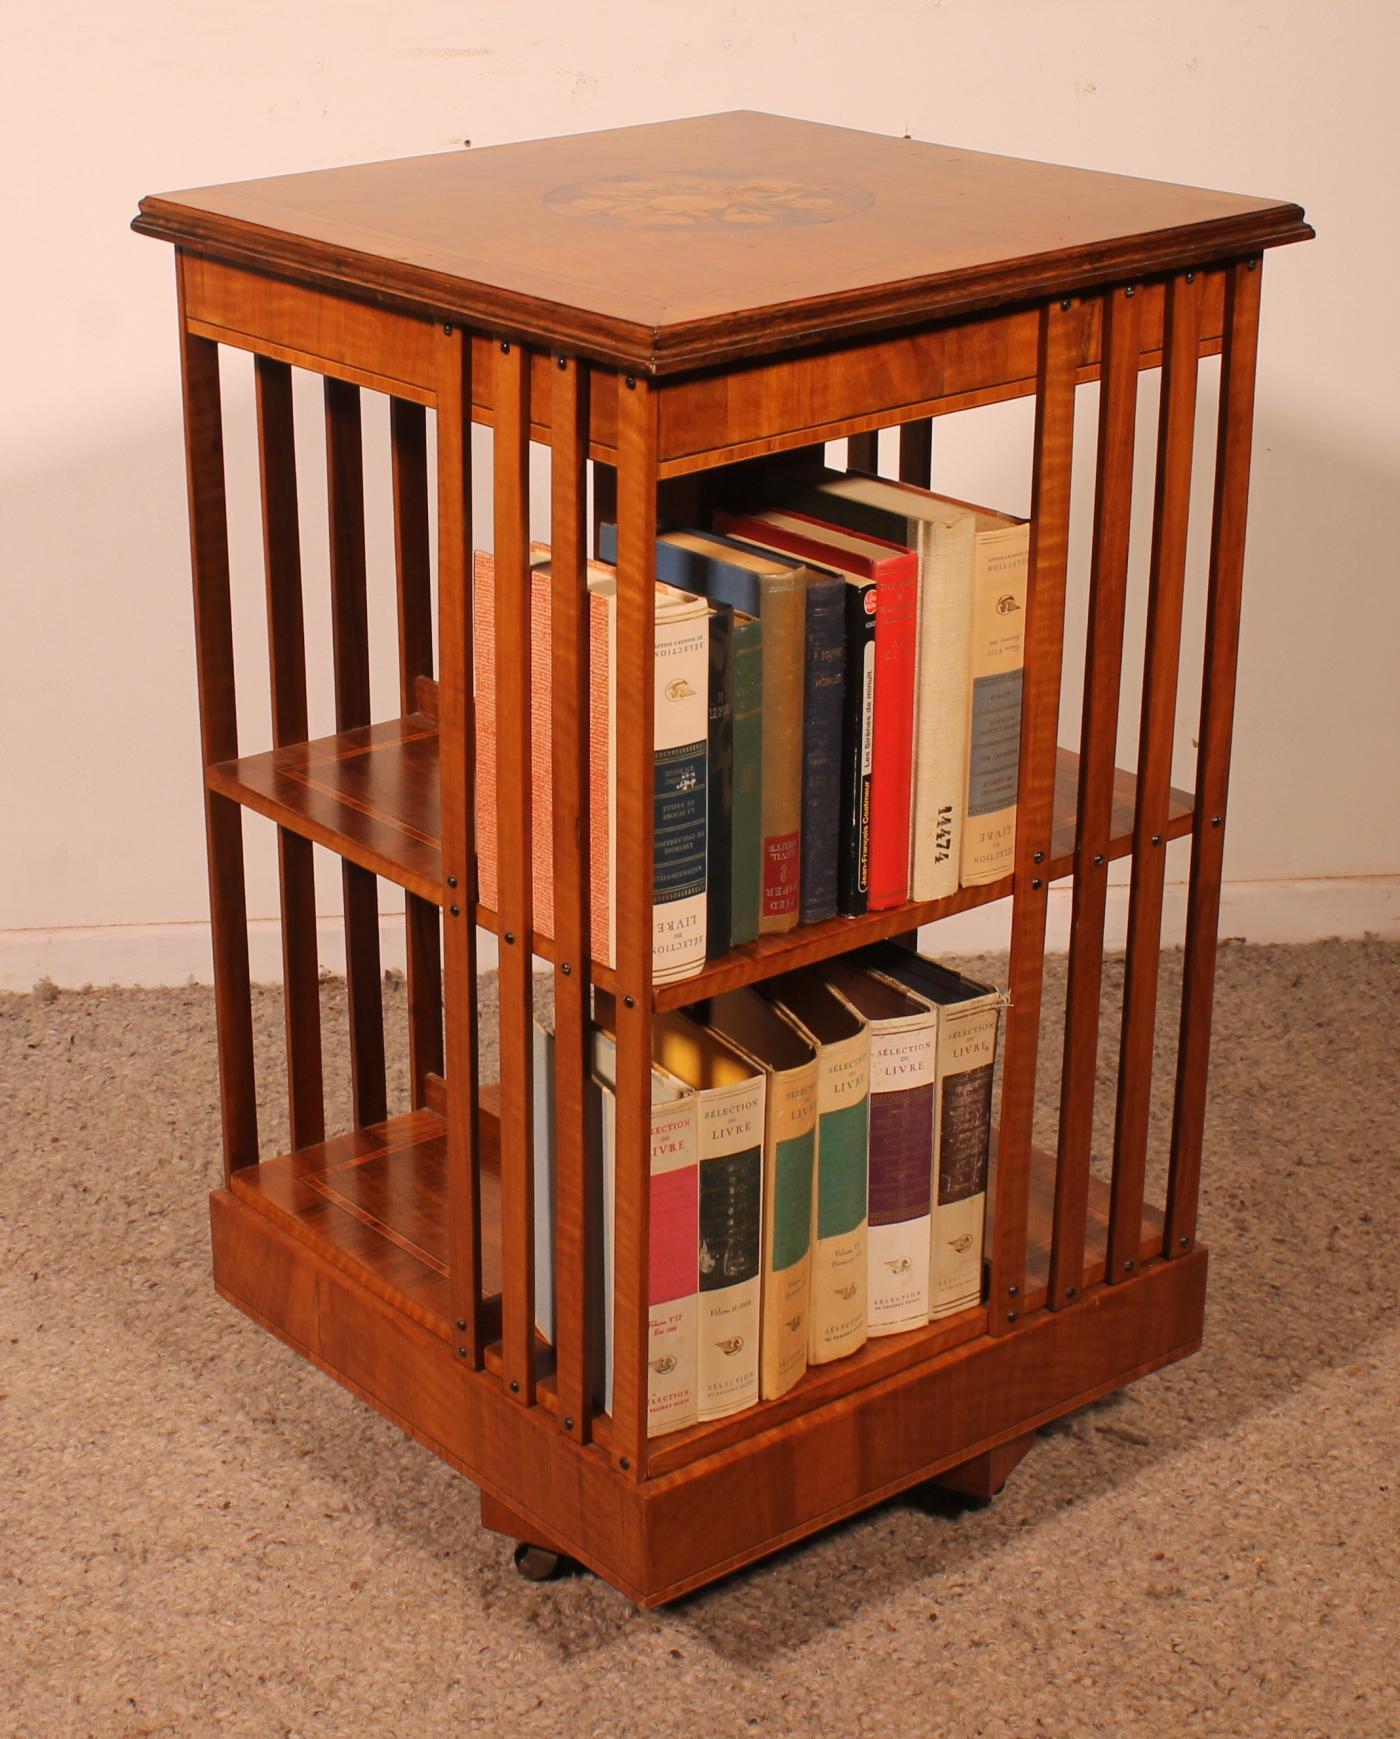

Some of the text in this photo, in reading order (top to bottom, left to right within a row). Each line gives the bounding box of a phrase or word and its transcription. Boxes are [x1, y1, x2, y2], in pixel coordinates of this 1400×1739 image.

[865, 701, 872, 714] de
[861, 825, 870, 887] Jean-François
[657, 914, 697, 933] LIVRE
[947, 1022, 994, 1040] SÉLECTION
[877, 1041, 931, 1057] SÉLECTION
[953, 1041, 988, 1058] LIVRE
[885, 1061, 924, 1076] LIVRE
[704, 1098, 758, 1120] SÉLECTION
[651, 1119, 691, 1136] LECTION
[712, 1121, 752, 1140] LIVRE
[651, 1139, 686, 1157] IVRE
[649, 1390, 689, 1405] LECTION
